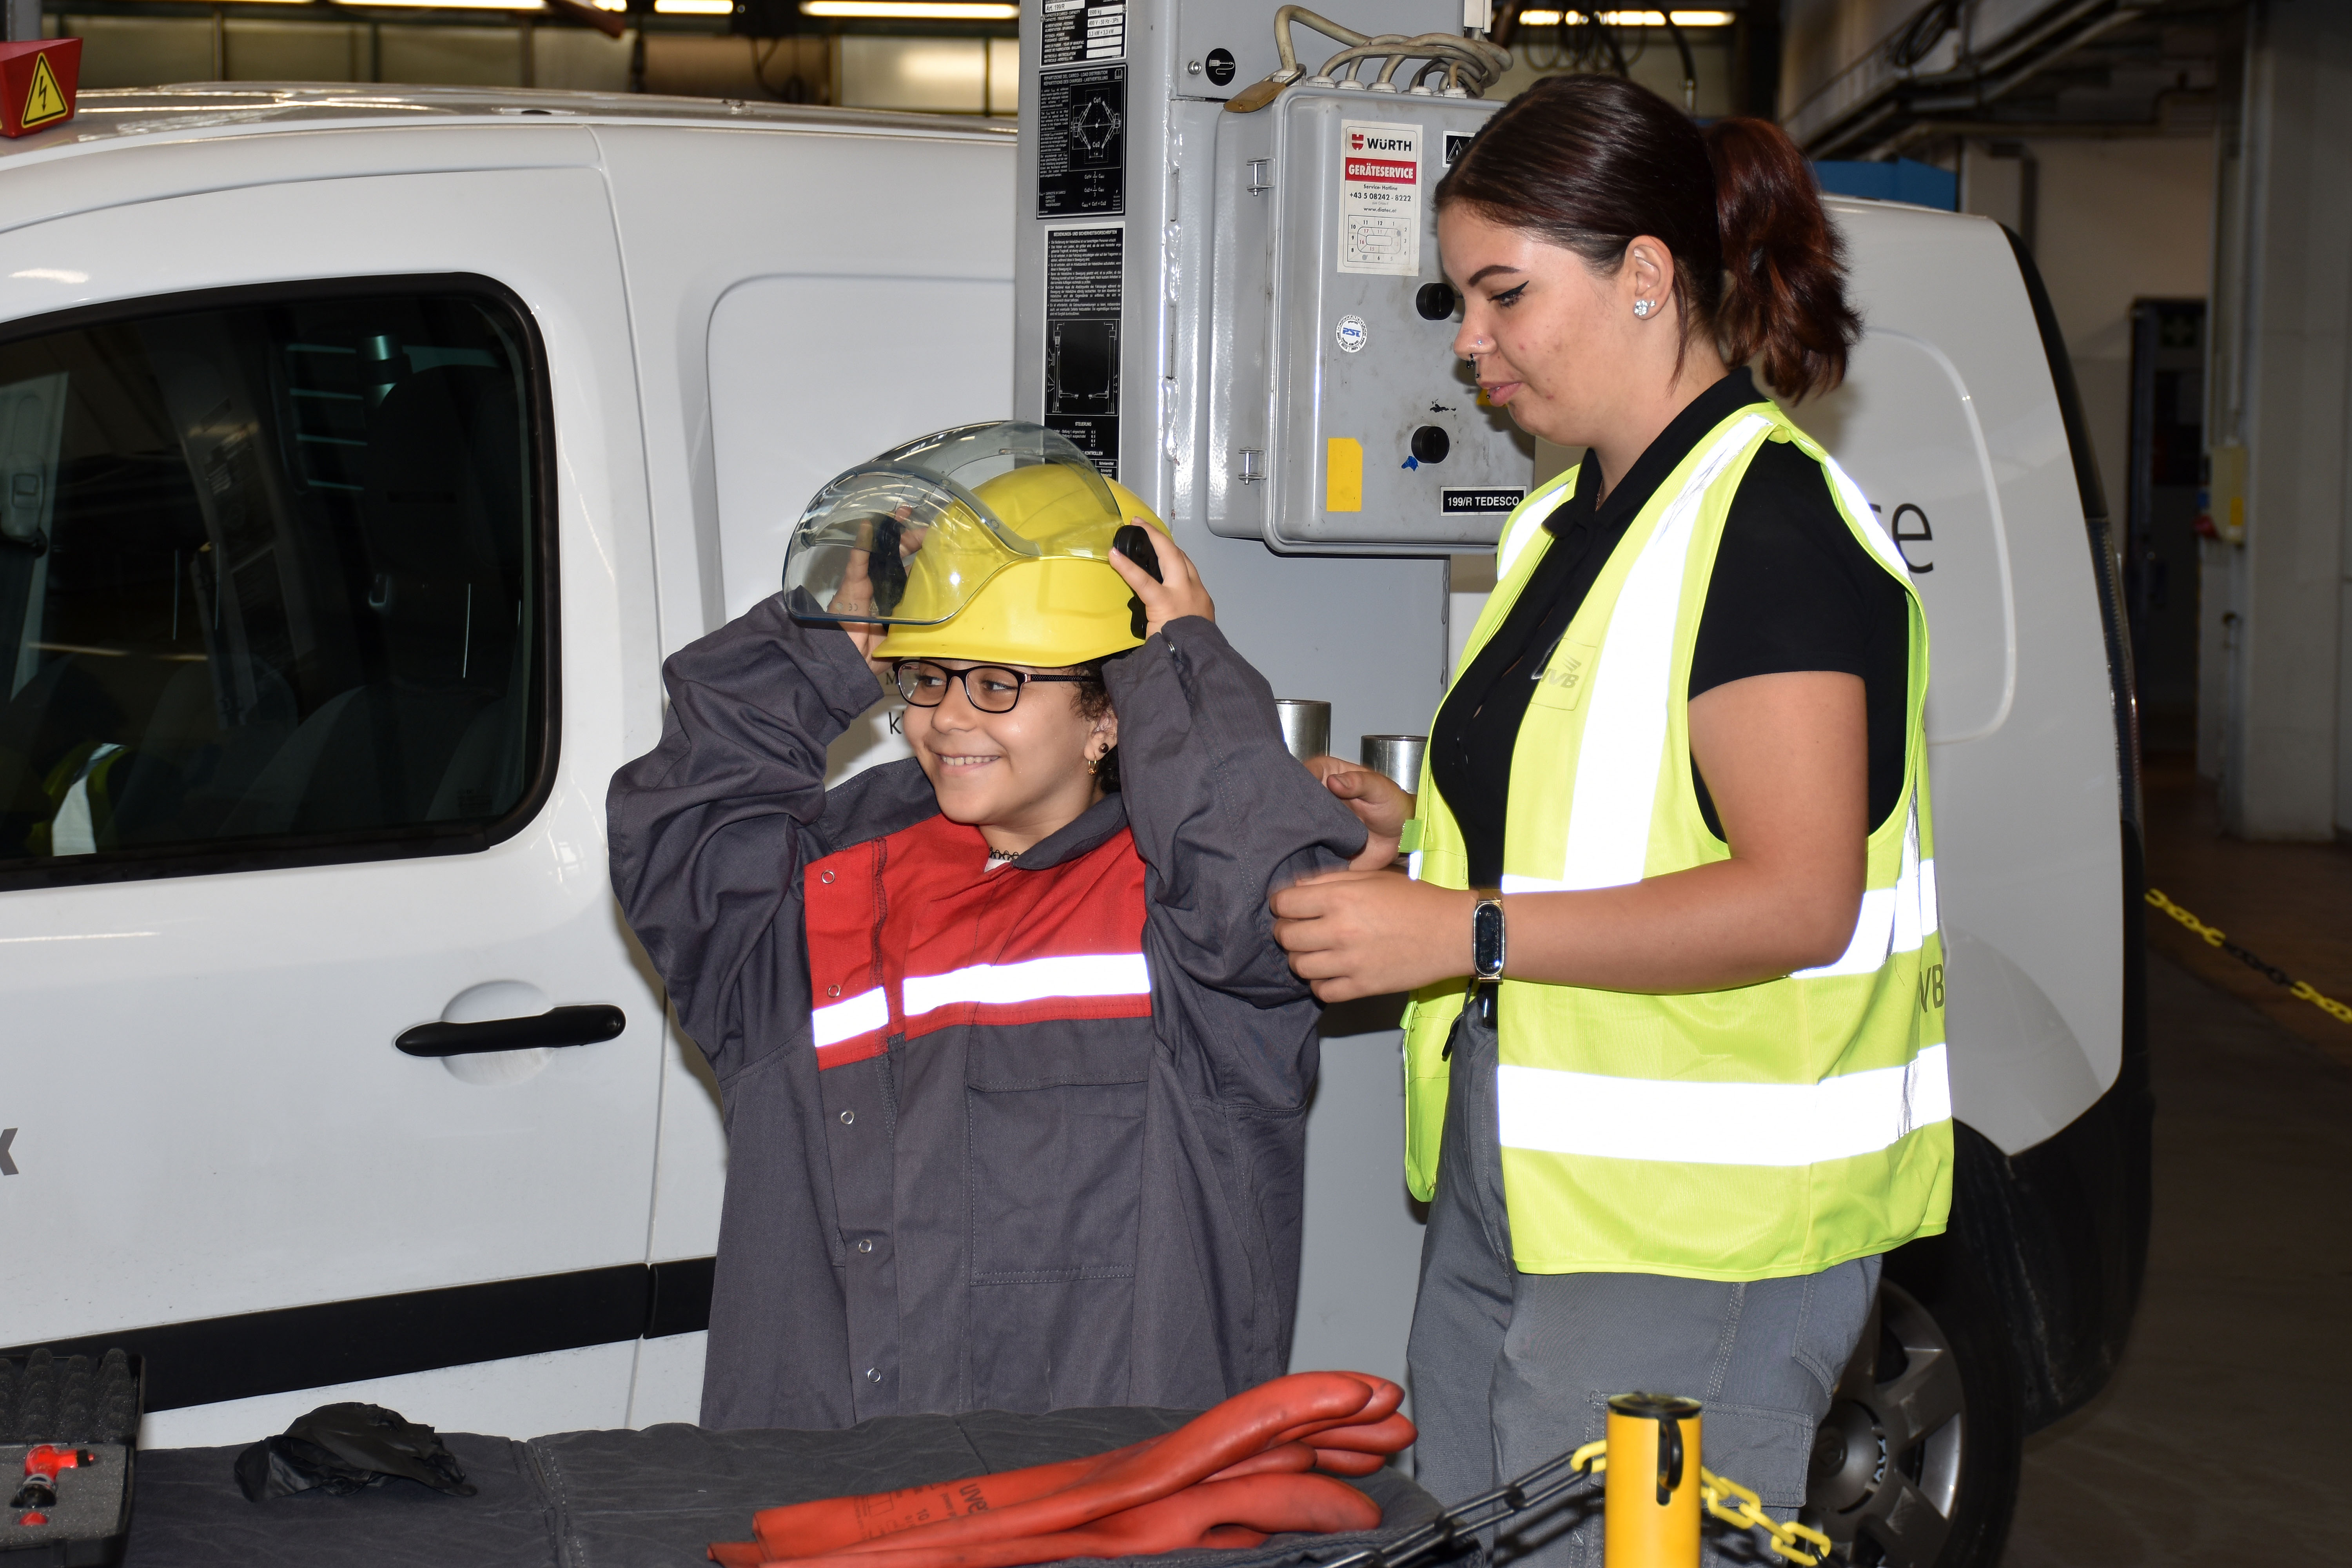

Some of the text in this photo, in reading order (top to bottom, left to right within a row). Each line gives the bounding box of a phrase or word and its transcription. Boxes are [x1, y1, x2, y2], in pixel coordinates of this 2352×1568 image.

[1367, 138, 1412, 152] WÜRTH
[1348, 163, 1414, 179] GERÄTESERVICE
[1448, 496, 1519, 506] 199/R TEDESCO
[888, 711, 905, 735] k
[959, 1483, 989, 1514] uve
